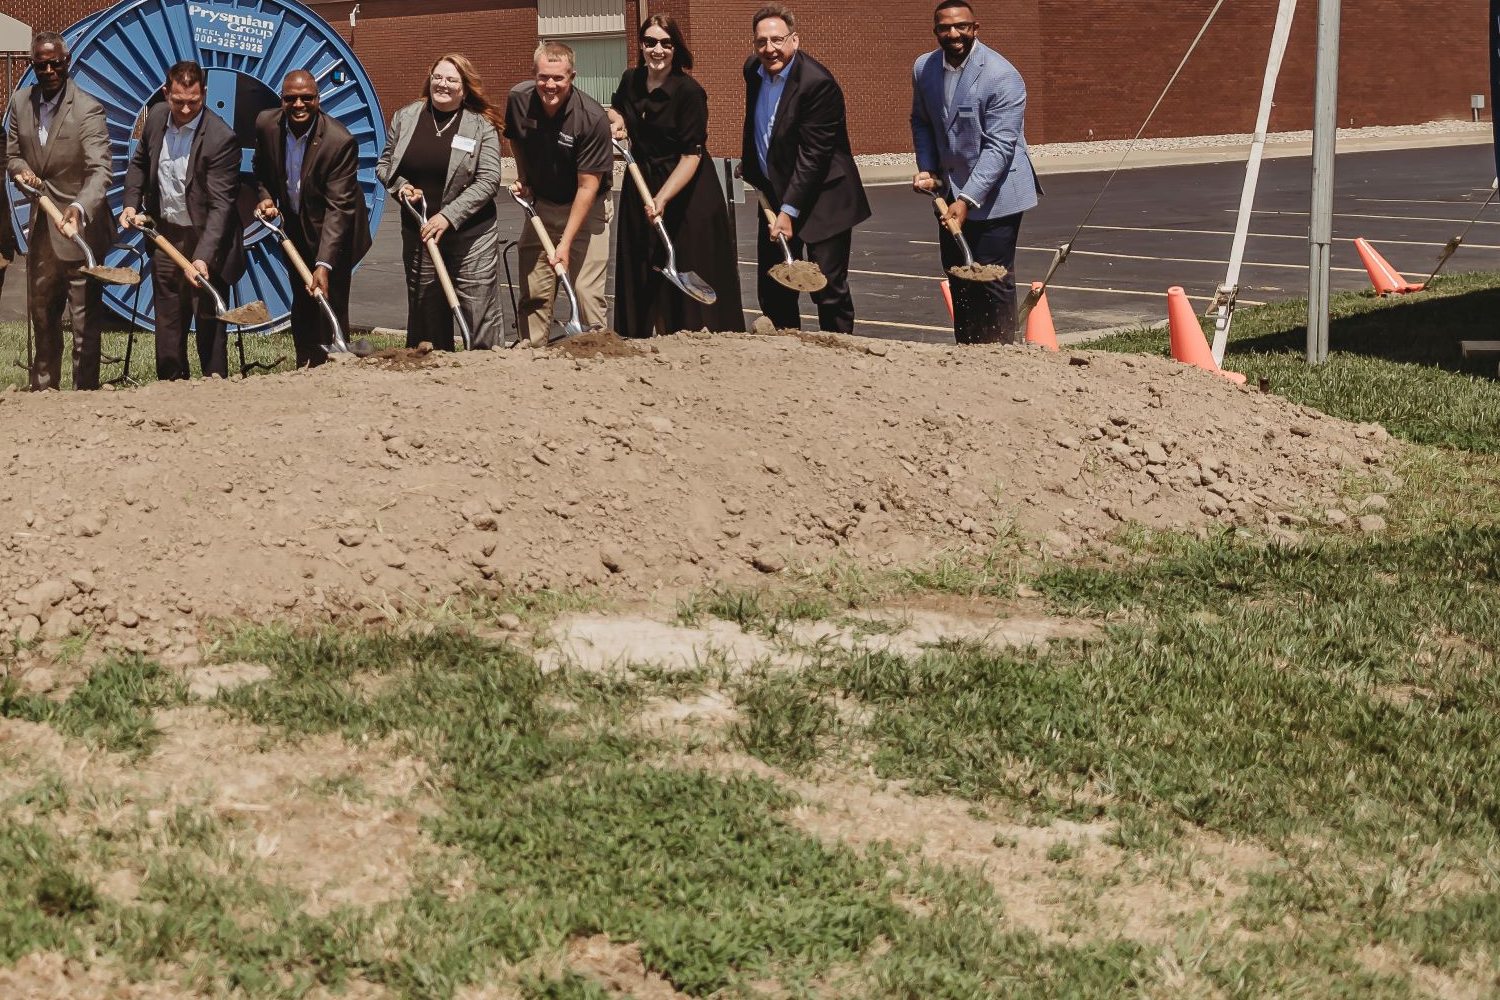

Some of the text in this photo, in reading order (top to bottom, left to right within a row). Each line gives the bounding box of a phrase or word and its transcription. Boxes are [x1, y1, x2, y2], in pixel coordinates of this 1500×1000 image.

[188, 4, 275, 31] Prysmian
[224, 32, 263, 44] RETURN
[227, 22, 274, 39] Group
